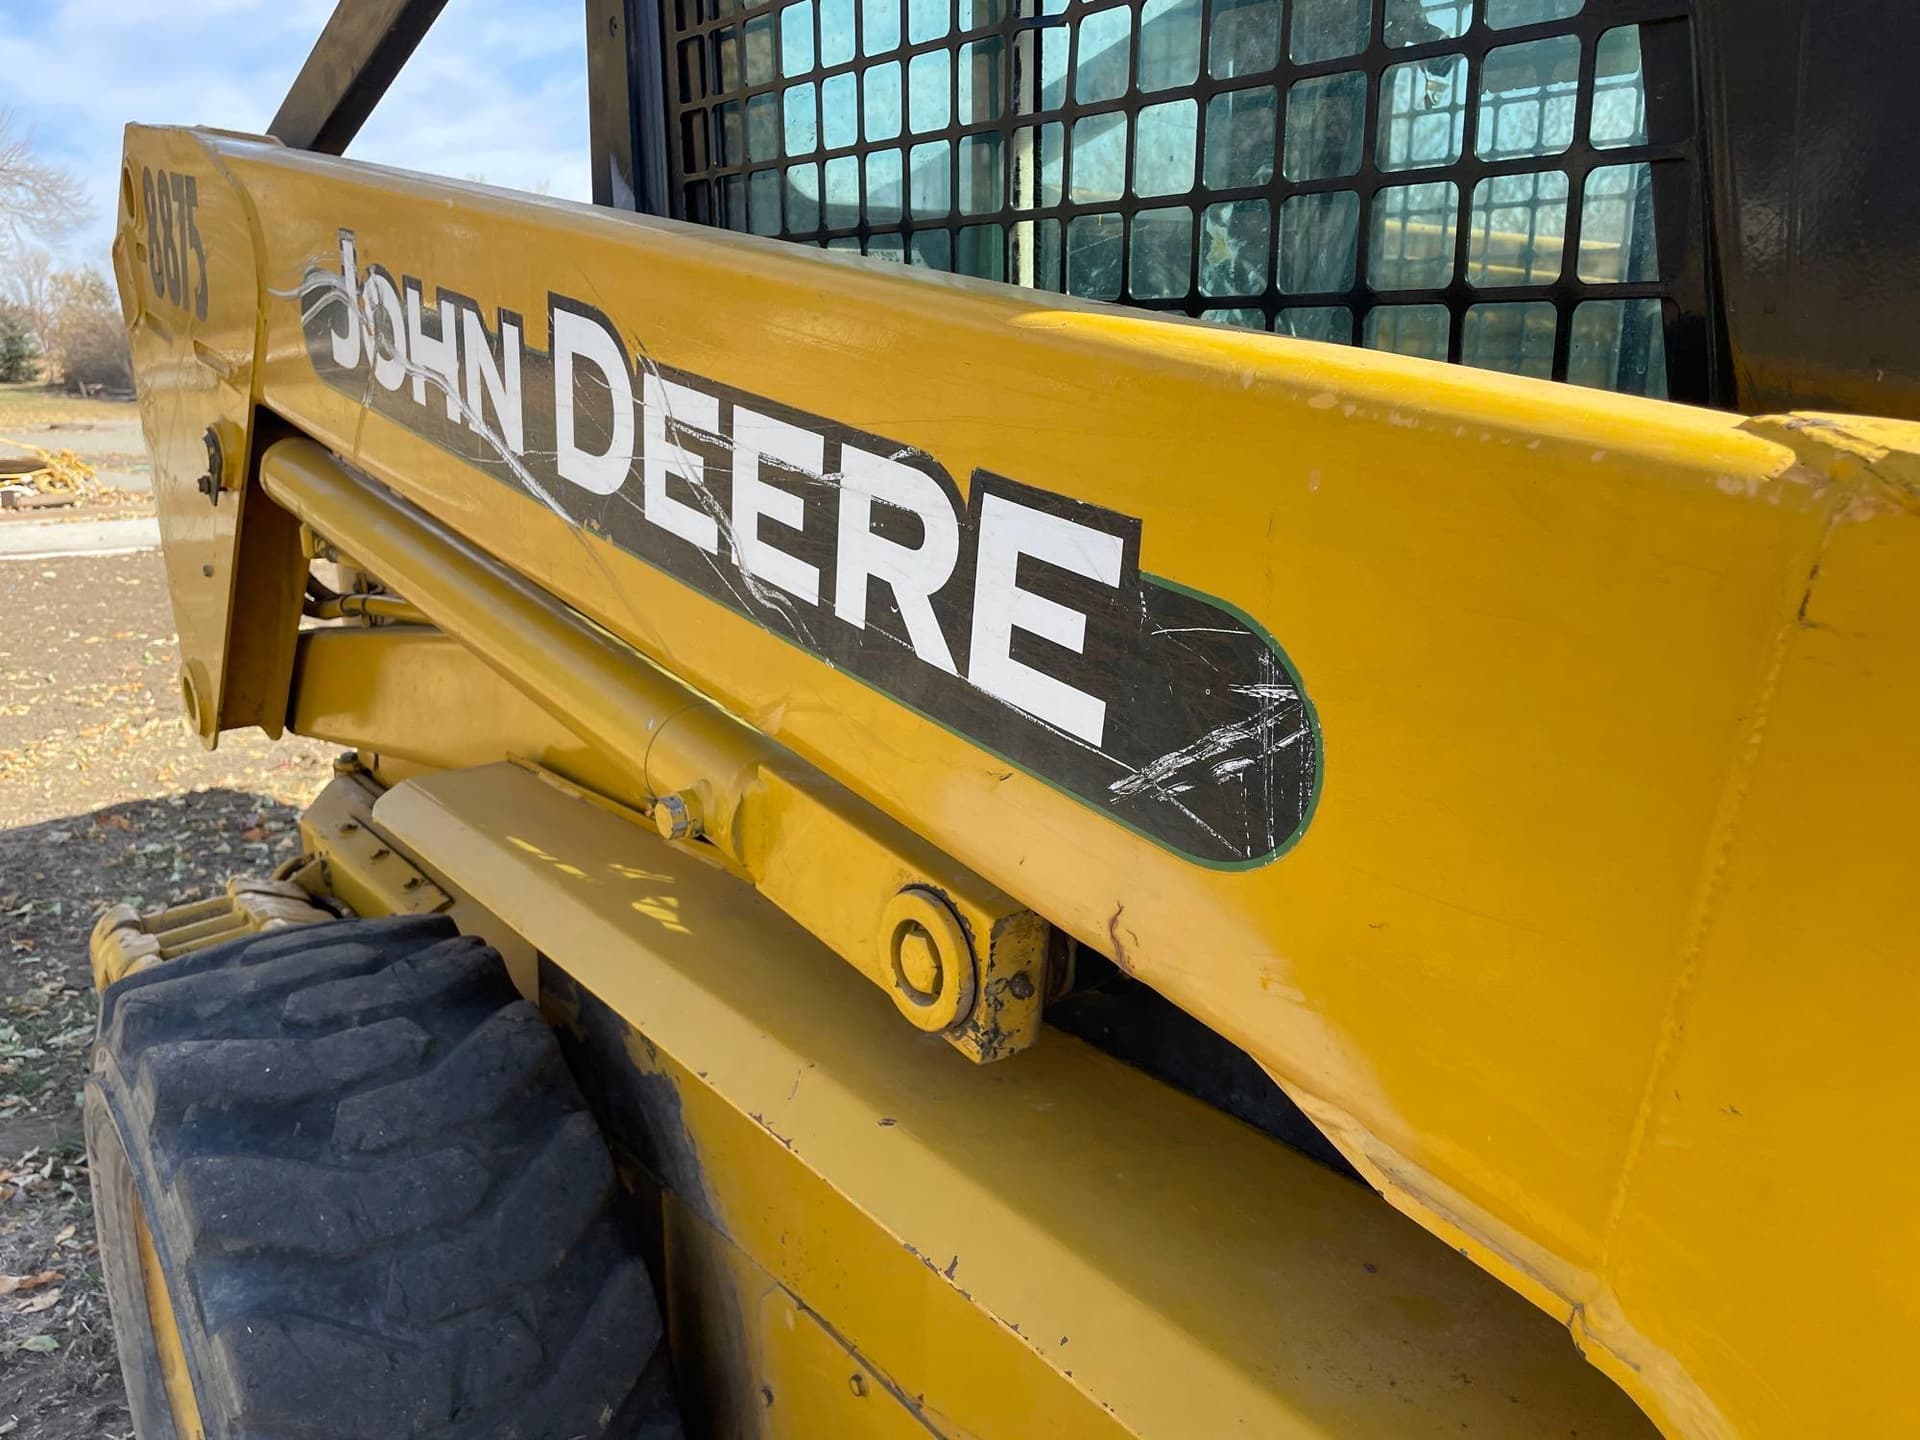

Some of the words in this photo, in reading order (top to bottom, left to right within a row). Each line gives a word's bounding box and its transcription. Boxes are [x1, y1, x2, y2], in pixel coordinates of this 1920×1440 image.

[143, 165, 208, 322] 8875
[330, 237, 525, 457] JOHN
[553, 307, 1124, 748] DEERE
